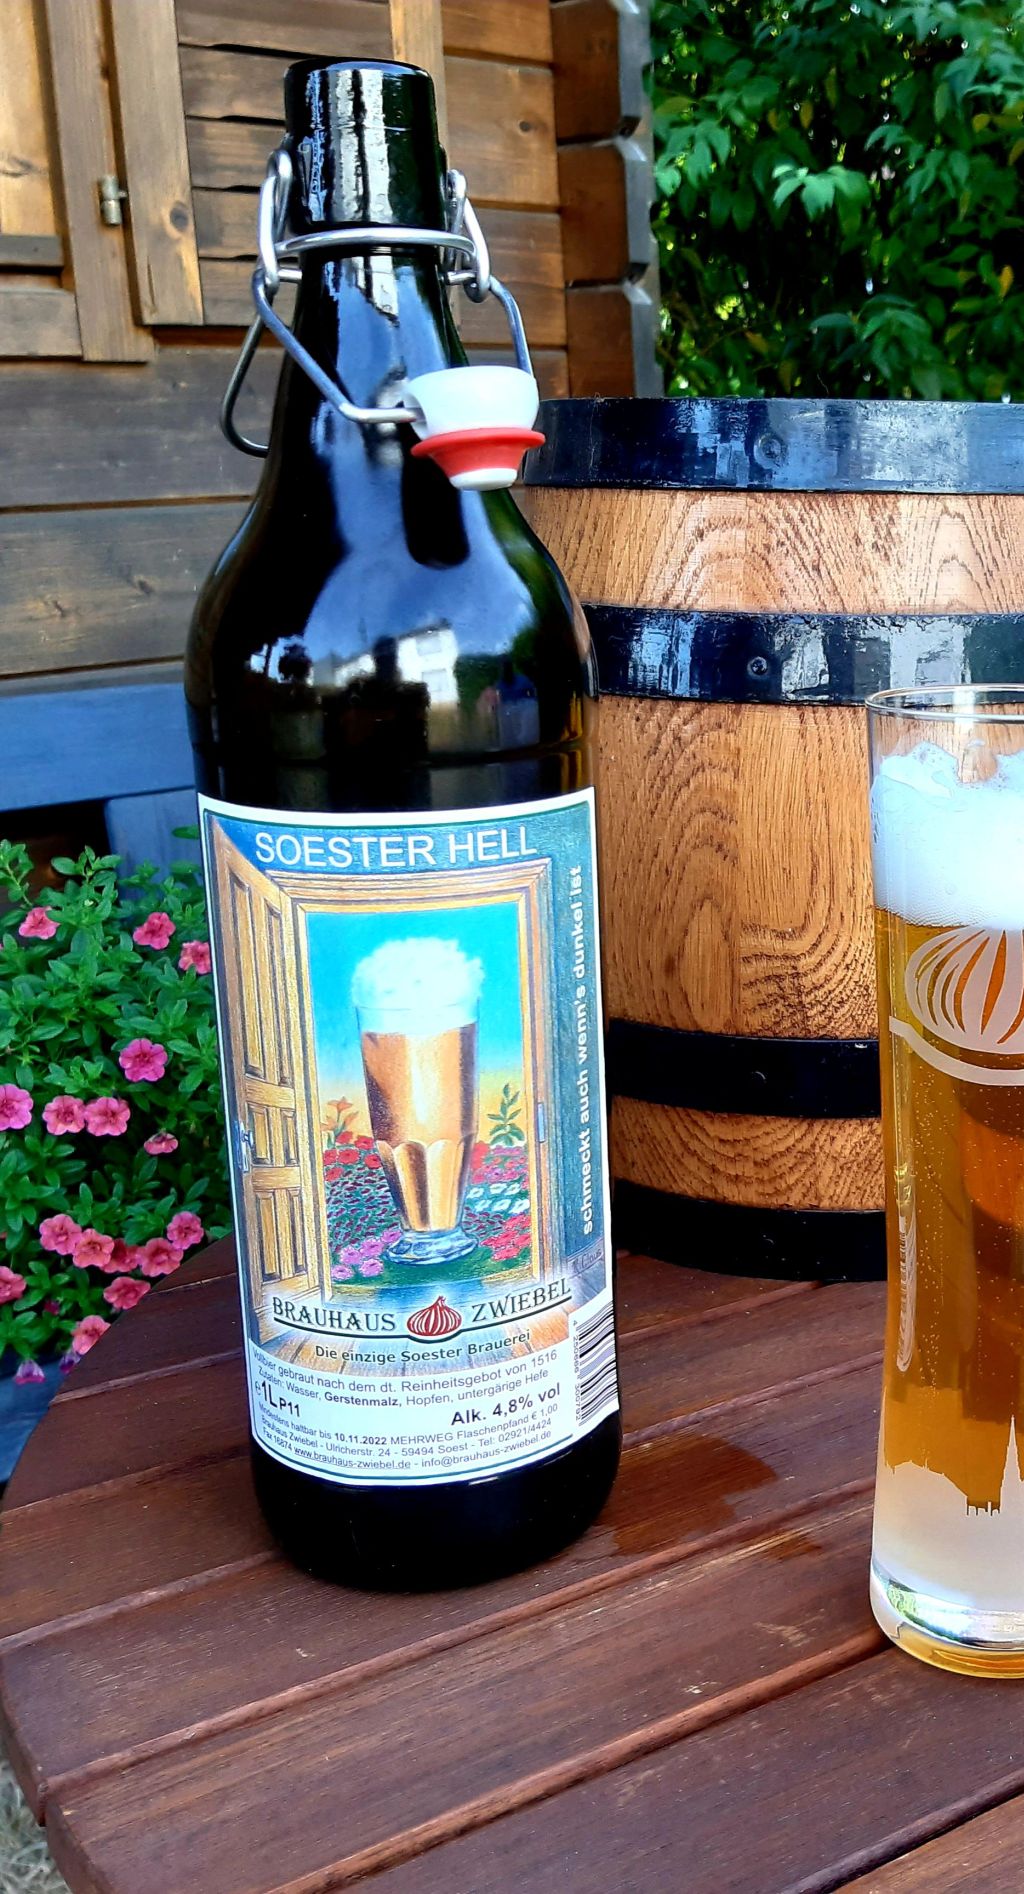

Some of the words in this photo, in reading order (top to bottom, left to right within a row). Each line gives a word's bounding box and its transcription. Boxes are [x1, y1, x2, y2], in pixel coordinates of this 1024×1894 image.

[255, 832, 436, 868] SOESTER
[448, 826, 537, 864] HELL
[569, 865, 582, 897] ist
[570, 901, 585, 979] dunkel
[574, 984, 588, 1065] wenn's
[576, 1069, 590, 1124] auch
[578, 1127, 593, 1236] schmeckt
[272, 1296, 396, 1332] BRAUHAUS
[471, 1277, 571, 1323] ZWIEBEL
[315, 1345, 337, 1358] Die
[342, 1350, 396, 1365] einzige
[401, 1347, 463, 1362] Soester
[467, 1329, 530, 1355] Brauerei
[278, 1366, 315, 1386] gebraut
[317, 1378, 345, 1391] nach
[349, 1381, 376, 1393] dem
[380, 1382, 397, 1393] dt.
[401, 1368, 501, 1393] Reinheitsgebot
[505, 1363, 527, 1377] von
[531, 1350, 558, 1368] 1516
[286, 1382, 322, 1401] Wasser,
[324, 1391, 402, 1408] Gerstenmalz,
[406, 1394, 454, 1407] Hopfen,
[457, 1380, 522, 1400] untergärige
[525, 1369, 549, 1385] Hefe
[279, 1397, 300, 1417] P11
[290, 1421, 317, 1437] haltbar
[319, 1429, 332, 1440] bis
[334, 1432, 387, 1445] 10.11.2022
[390, 1431, 454, 1445] MEHRWEG
[457, 1413, 529, 1440] Flaschenpfand
[541, 1403, 558, 1417] 1,00
[451, 1408, 487, 1426] Alk.
[492, 1394, 533, 1417] 4,8%
[538, 1382, 560, 1403] vol
[289, 1432, 318, 1449] Zwiebel
[325, 1442, 375, 1457] Ulricherstr.
[378, 1448, 391, 1457] 24
[401, 1446, 434, 1457] 59494
[438, 1442, 468, 1455] Soest
[479, 1436, 495, 1447] Tel:
[499, 1418, 552, 1443] 02921/4424
[294, 1446, 411, 1470] www.brauhaus-zwiebel.de
[421, 1430, 552, 1468] info@brauhaus-zwiebel.de
